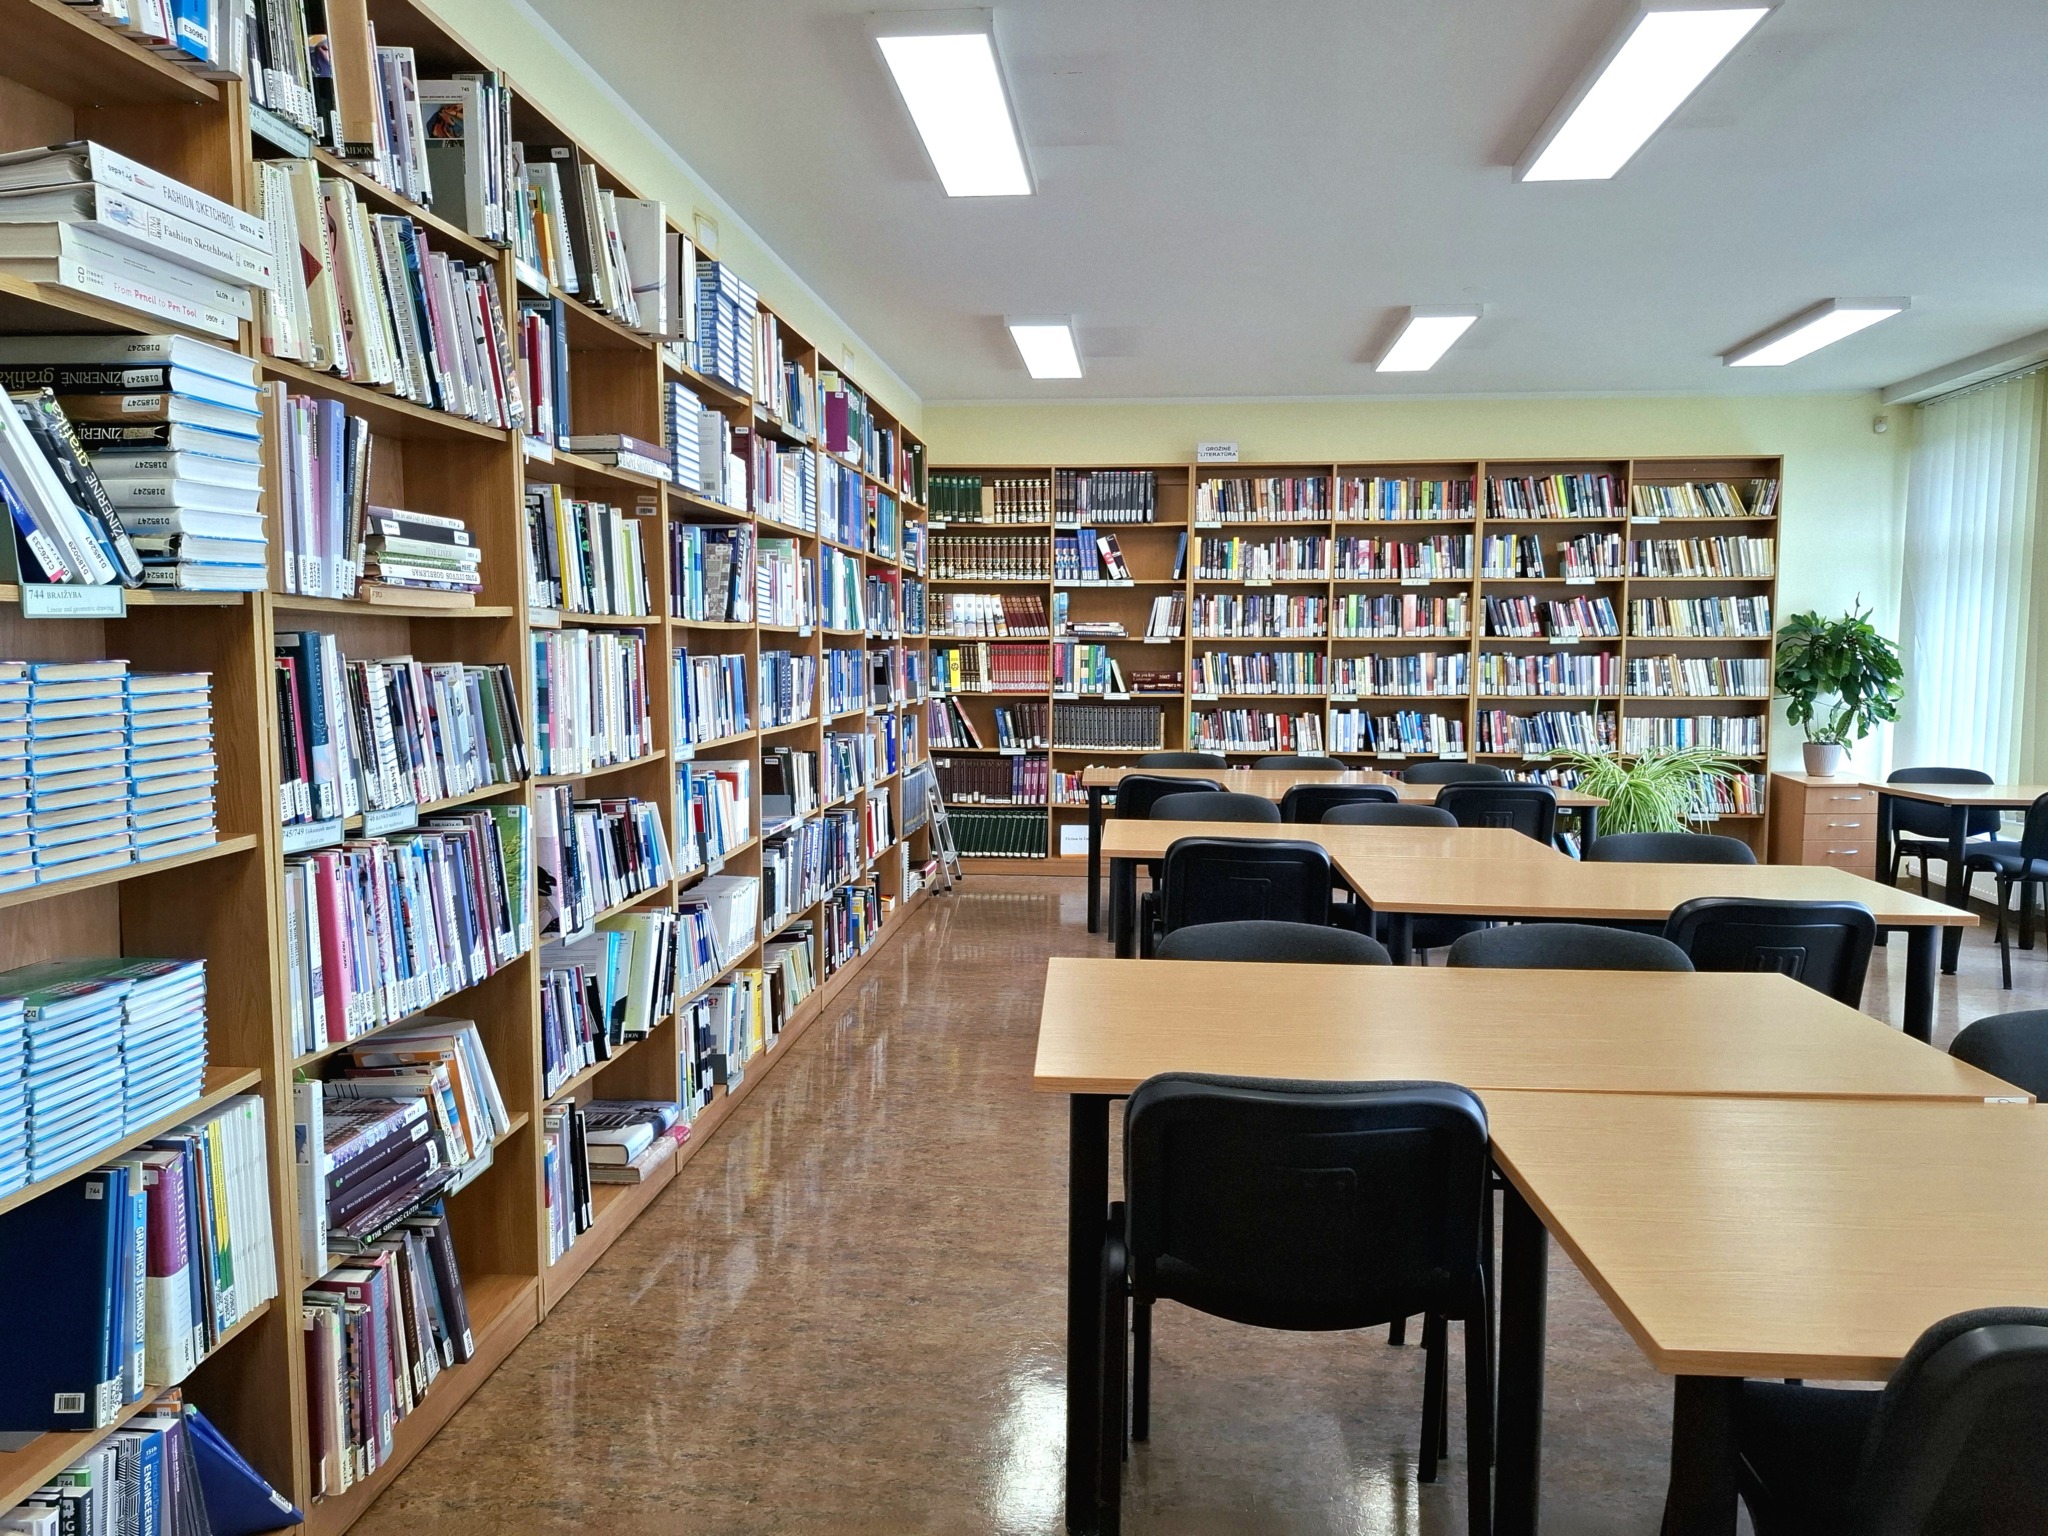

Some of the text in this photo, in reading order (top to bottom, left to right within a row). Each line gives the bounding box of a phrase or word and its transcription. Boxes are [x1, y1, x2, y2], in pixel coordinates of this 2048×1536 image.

[183, 24, 208, 42] E30961
[345, 146, 373, 155] AIDON
[163, 185, 195, 211] FASHION
[344, 199, 353, 230] WOOD
[163, 225, 234, 262] Fashion Sketchbook
[77, 266, 85, 283] CD
[113, 283, 197, 318] From Pencil to Pen Tool
[127, 343, 160, 352] D185247
[61, 370, 124, 385] ŽINERINĖ
[127, 373, 159, 383] D185247
[127, 398, 160, 407] D185247
[51, 402, 89, 468] grafika
[78, 422, 123, 440] ŽINERI
[134, 460, 167, 470] D185247
[132, 487, 165, 496] D185247
[137, 516, 170, 526] D185247
[31, 536, 55, 571] C126233
[68, 541, 89, 575] D185029
[85, 536, 107, 570] D185247
[146, 571, 174, 580] D18524
[28, 588, 82, 600] 744 BRAIŽYBA
[46, 604, 115, 614] Linear and geometric drawing
[89, 1187, 101, 1195] 744
[176, 1165, 188, 1265] Furniture
[371, 1203, 420, 1241] THE SHINING CLOTH
[135, 1226, 144, 1277] GRAPHICS
[136, 1277, 144, 1344] TECHNOLOGY
[145, 1447, 157, 1455] 15th
[151, 1459, 160, 1496] Technical
[144, 1464, 154, 1536] ENGINEERIN
